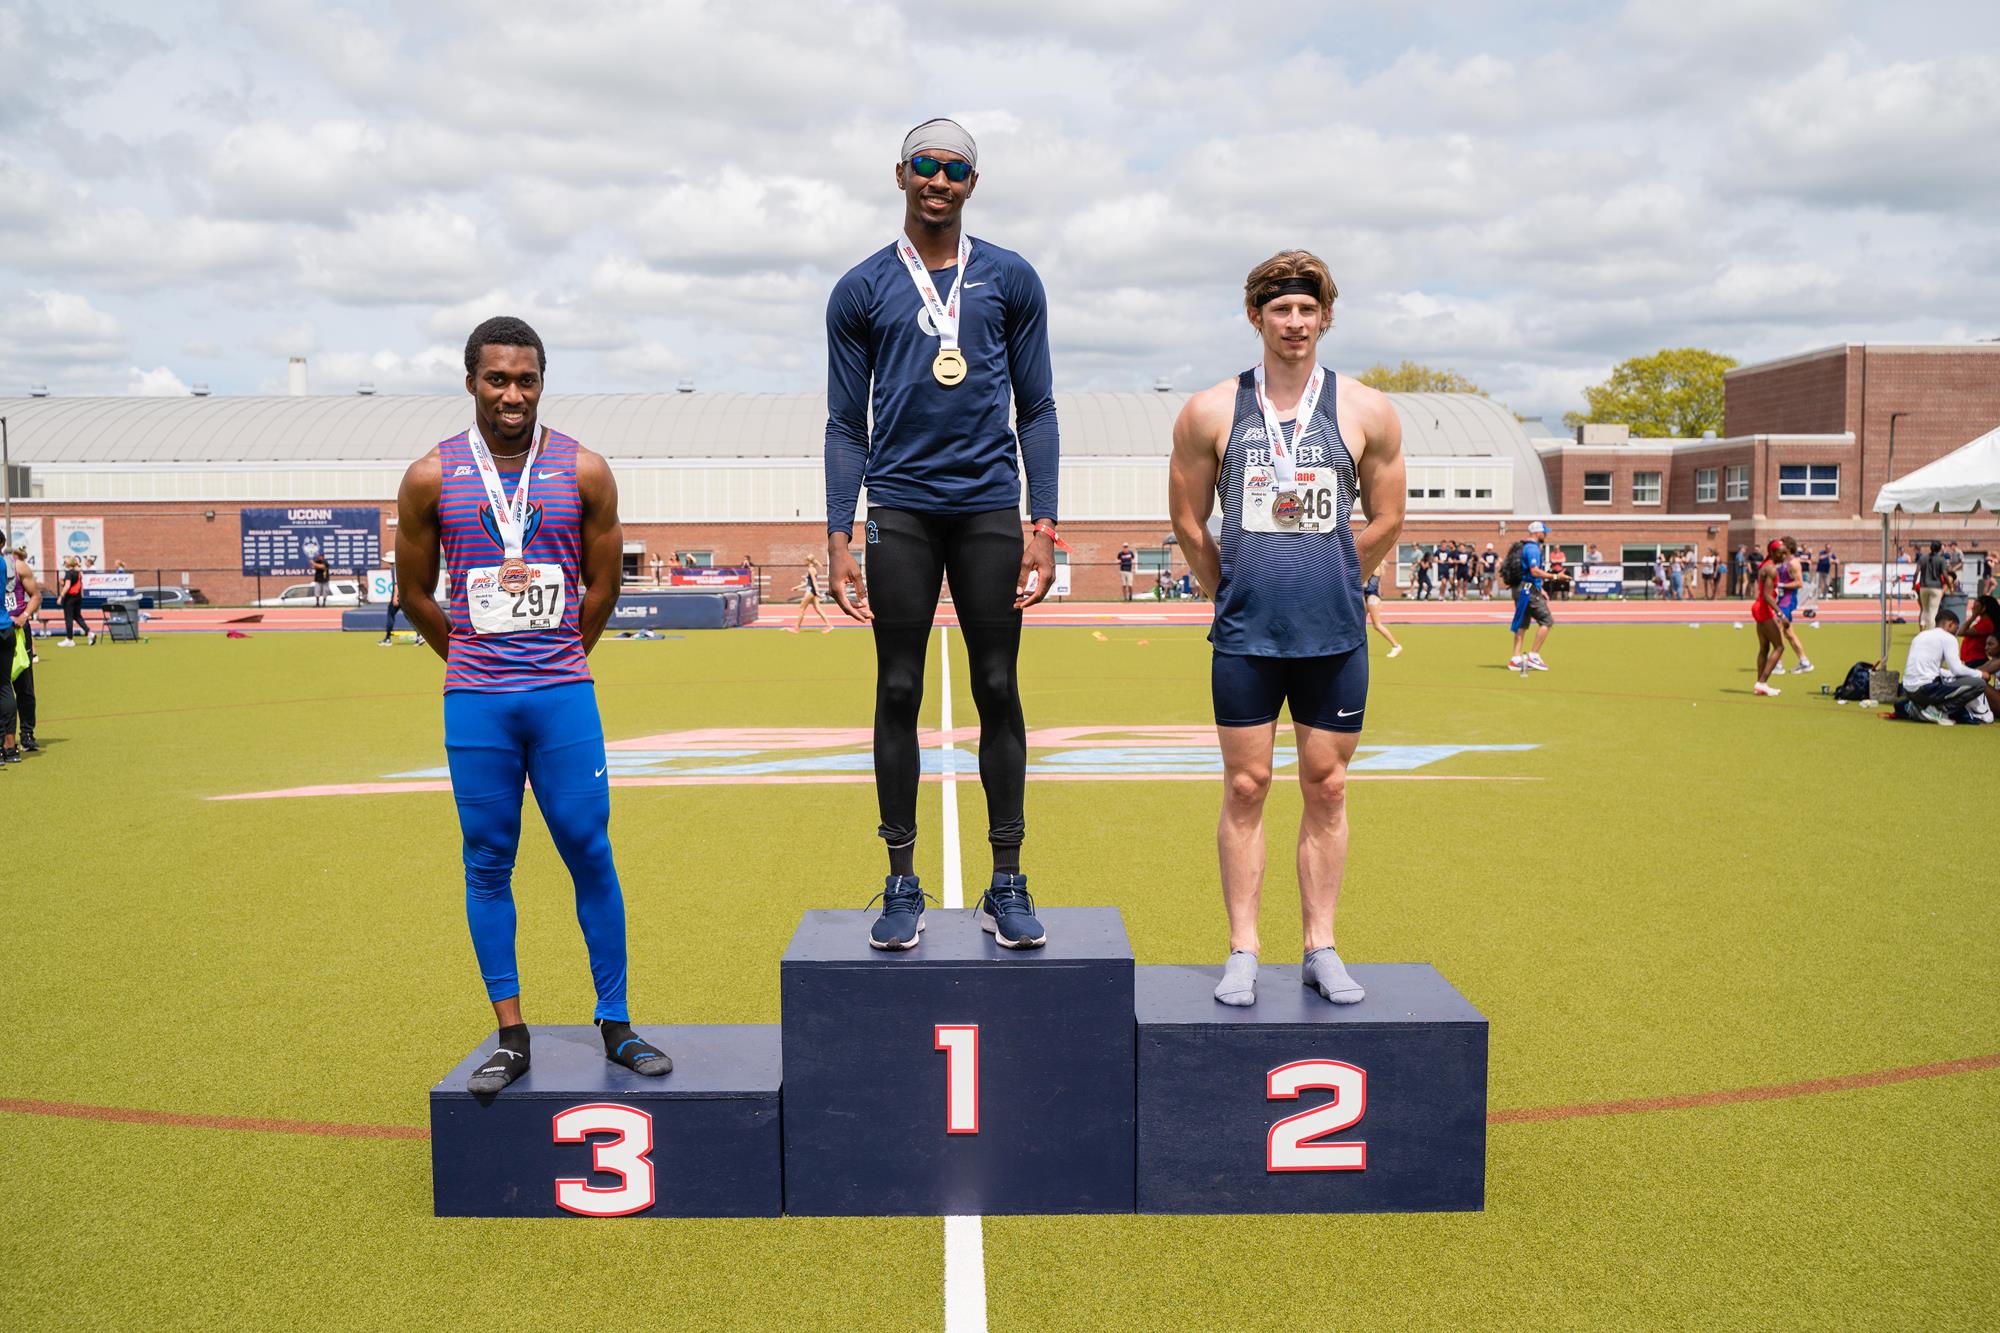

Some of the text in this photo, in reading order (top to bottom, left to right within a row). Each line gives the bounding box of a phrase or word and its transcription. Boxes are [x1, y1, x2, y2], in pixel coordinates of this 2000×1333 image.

[912, 254, 922, 271] EAST
[930, 297, 944, 316] EAST
[1246, 446, 1325, 466] BUER
[288, 509, 332, 520] UCONN
[1302, 488, 1332, 519] 46
[512, 584, 560, 618] 297
[615, 607, 647, 616] UCS
[934, 1024, 979, 1134] 1
[1266, 1058, 1367, 1171] 2
[552, 1102, 655, 1217] 3
